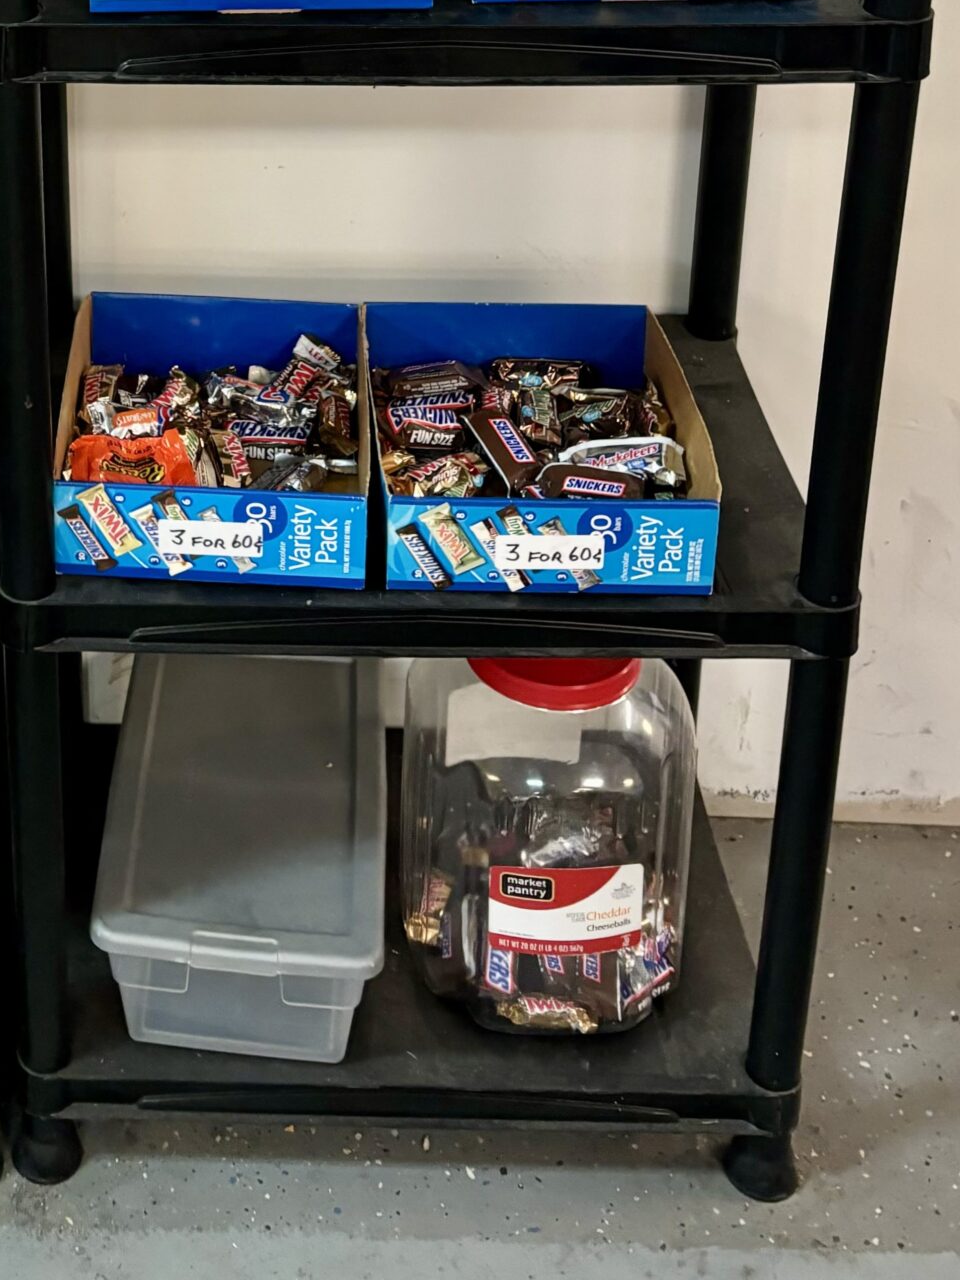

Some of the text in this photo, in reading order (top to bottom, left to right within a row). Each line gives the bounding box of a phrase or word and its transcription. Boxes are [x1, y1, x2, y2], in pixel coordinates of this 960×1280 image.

[410, 430, 456, 446] FUN SIZE
[493, 419, 531, 461] SNICKERS
[243, 446, 266, 460] FUN
[590, 443, 659, 468] Musketeers
[566, 478, 623, 494] SNICKERS
[89, 495, 125, 547] TWIX
[70, 519, 106, 560] SNICKERS
[170, 529, 264, 554] 3 FOR 60¢
[288, 504, 318, 571] Variety
[314, 518, 338, 564] Pack
[630, 515, 664, 581] Variety
[658, 527, 685, 572] Pack
[405, 533, 446, 583] SNICKERS
[505, 544, 602, 563] 3 FOR 60¢
[507, 875, 547, 888] market
[507, 885, 547, 899] pantry
[586, 907, 632, 921] Cheddar
[586, 919, 632, 932] Cheeseballs
[499, 938, 510, 947] NET
